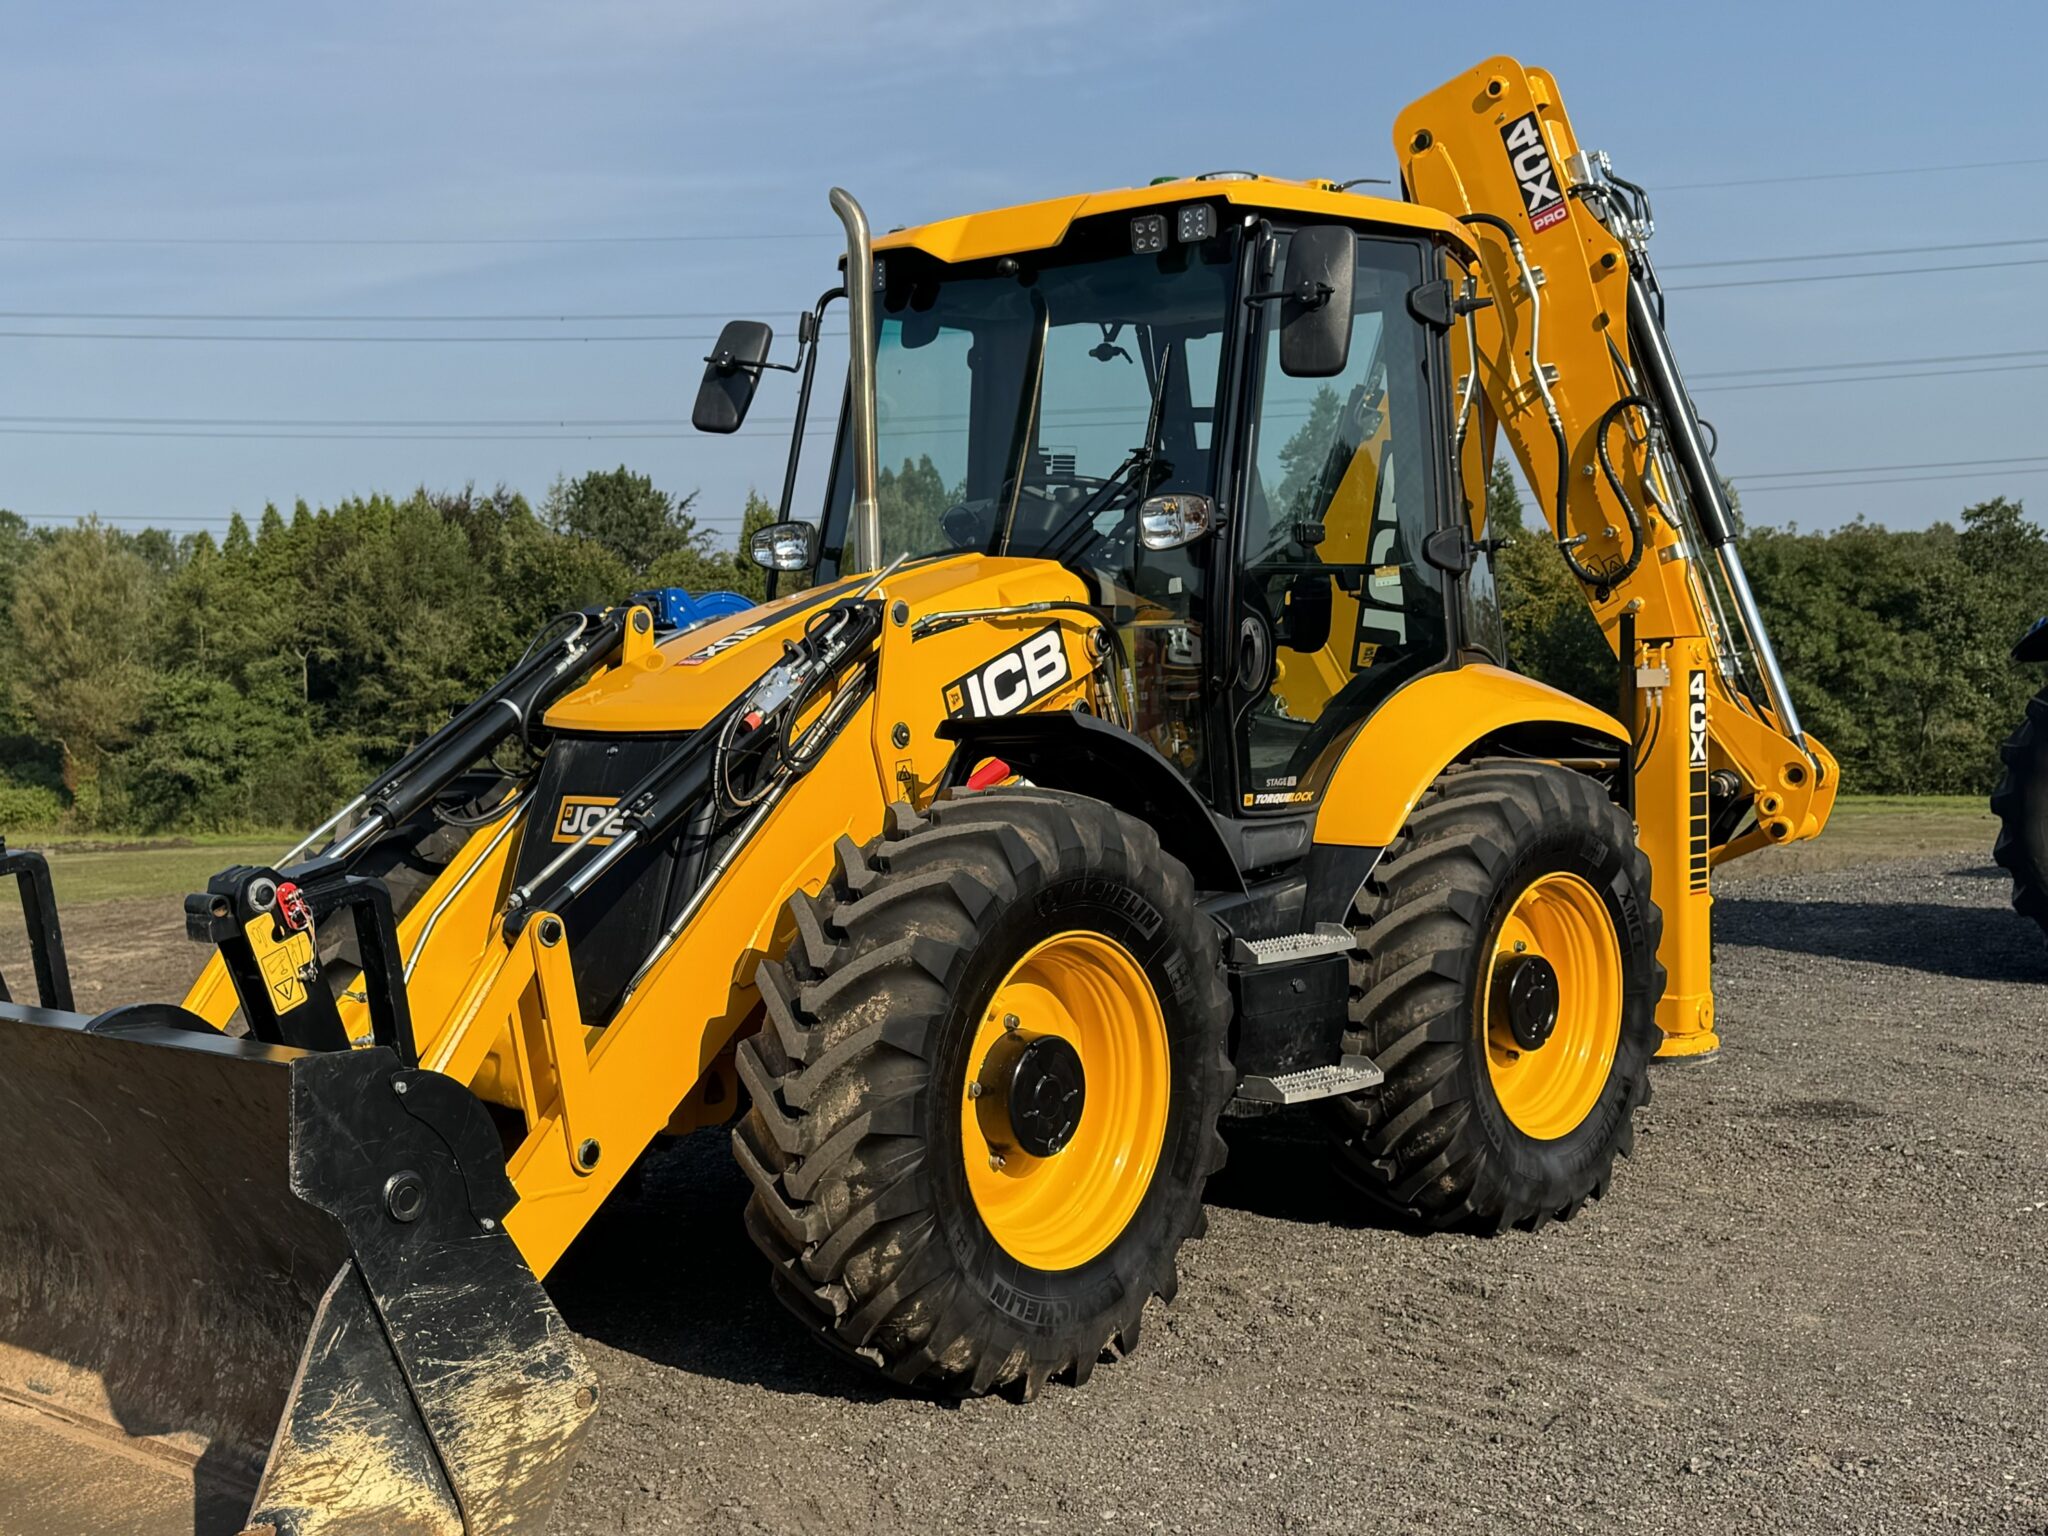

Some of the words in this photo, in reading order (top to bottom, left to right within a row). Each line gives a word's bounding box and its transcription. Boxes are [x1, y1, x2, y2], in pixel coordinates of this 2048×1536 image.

[1506, 117, 1561, 212] 4CX
[1533, 207, 1568, 231] PRO
[1690, 672, 1706, 761] 4CX
[1255, 791, 1314, 805] TORQUELOCK
[1266, 777, 1287, 787] STAGE
[1058, 879, 1162, 932] ICHELIN
[989, 1283, 1094, 1326] ICHELIN
